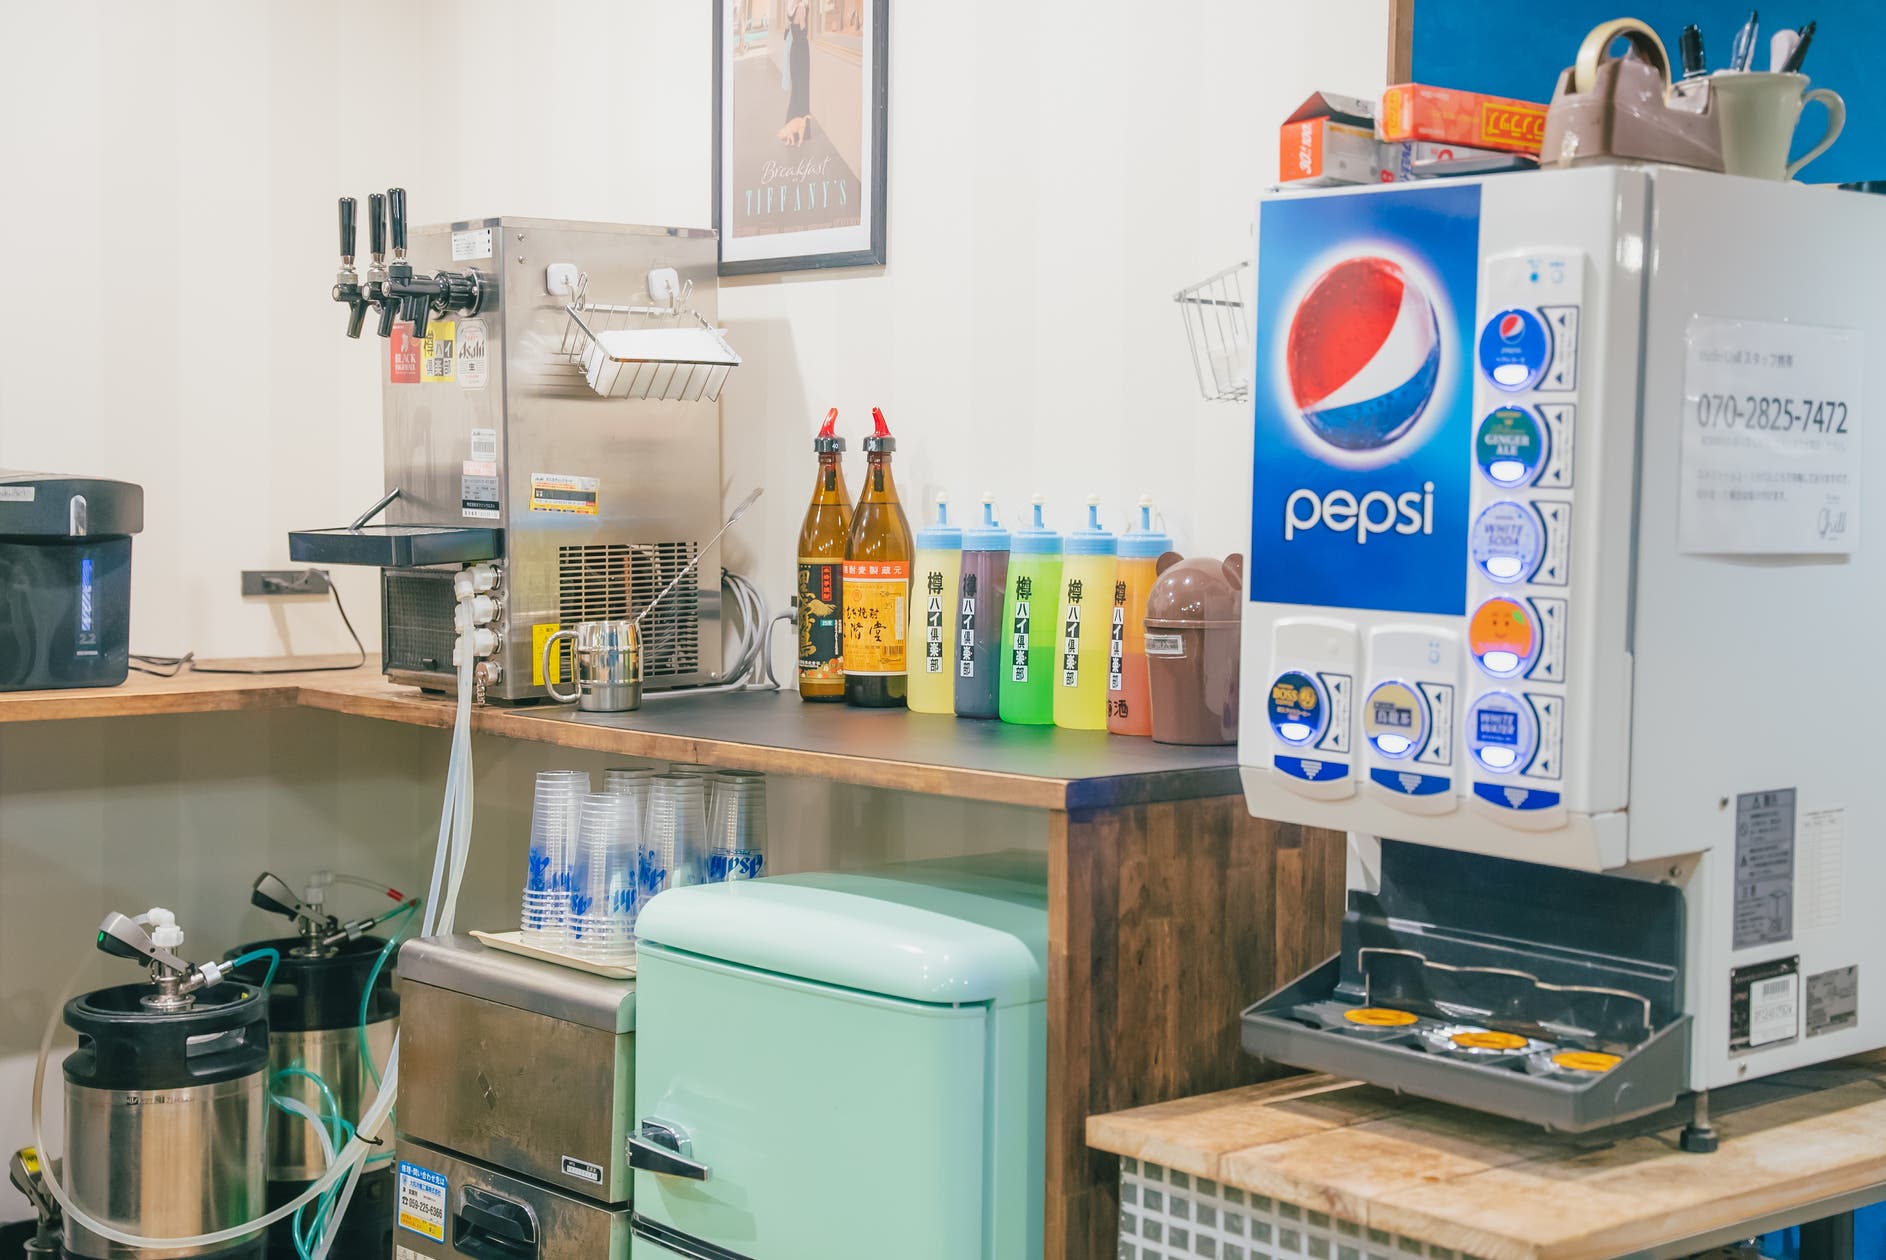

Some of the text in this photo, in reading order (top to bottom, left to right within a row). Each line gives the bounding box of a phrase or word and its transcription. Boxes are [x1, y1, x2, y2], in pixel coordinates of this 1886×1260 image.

[761, 156, 832, 185] Breakfast
[746, 179, 847, 217] TIFFANY'S
[1698, 393, 1848, 435] 070-2825-7472
[1284, 481, 1435, 544] pepsi
